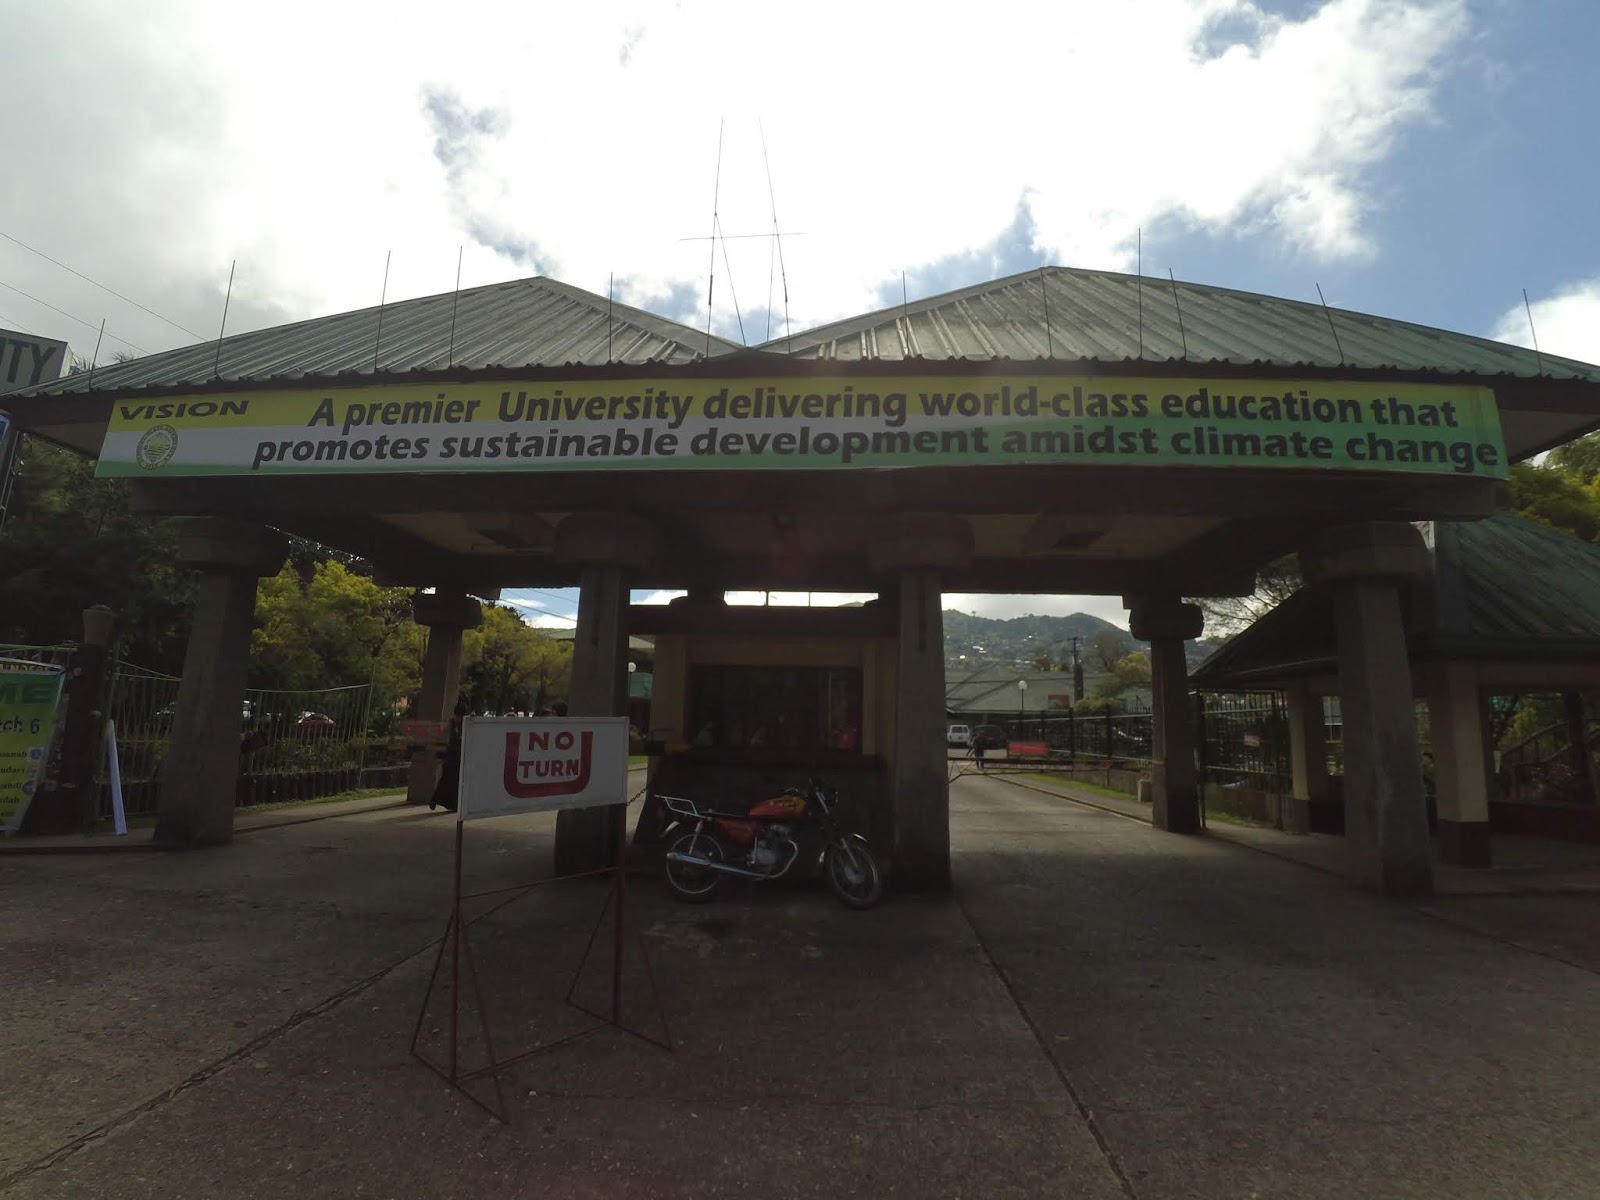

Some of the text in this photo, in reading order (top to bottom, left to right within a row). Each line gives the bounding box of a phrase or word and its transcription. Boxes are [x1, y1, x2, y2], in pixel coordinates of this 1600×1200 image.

[120, 399, 250, 421] VISION
[306, 386, 1459, 436] A premier University delivering world-class education that
[251, 425, 1499, 474] promotes sustainable development amidst climate change
[0, 715, 40, 734] ch 6
[528, 731, 575, 751] NO
[518, 759, 579, 778] TURN
